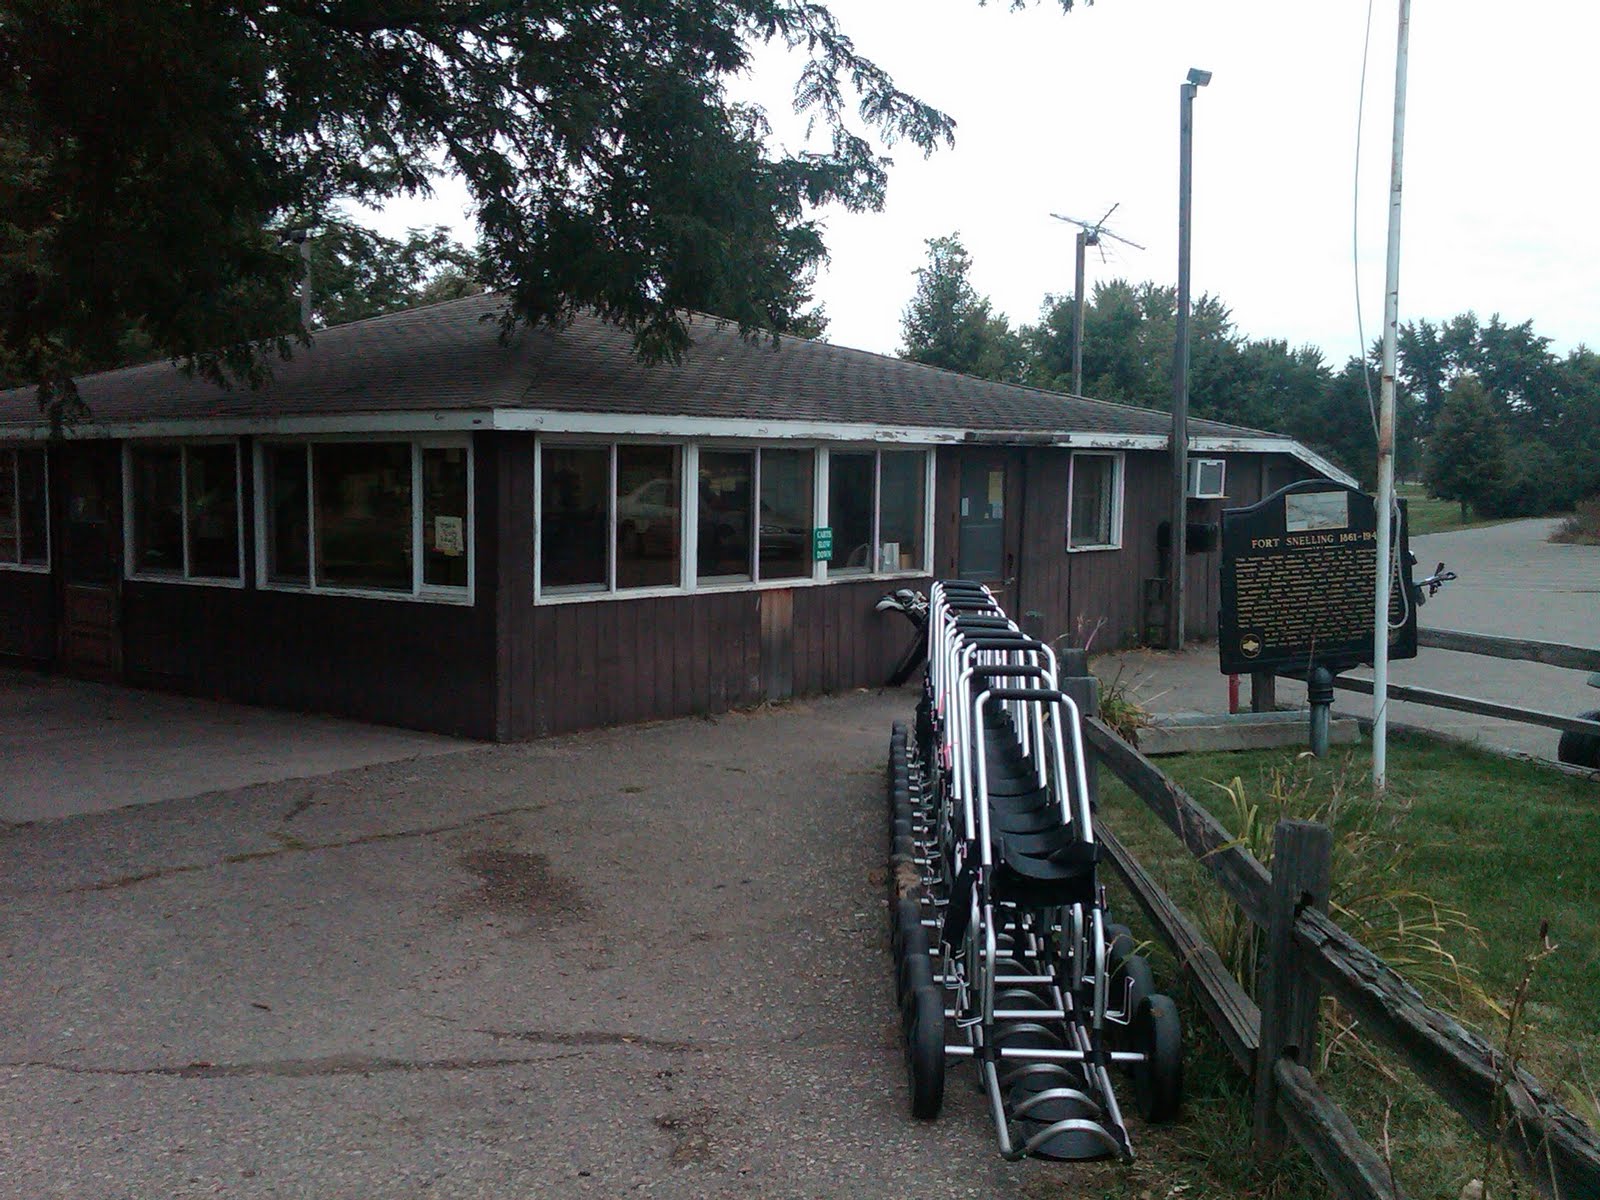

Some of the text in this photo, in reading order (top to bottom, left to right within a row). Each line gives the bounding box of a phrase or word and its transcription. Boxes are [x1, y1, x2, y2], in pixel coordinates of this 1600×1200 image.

[1251, 531, 1377, 549] FORT SNELLING 1861-194
